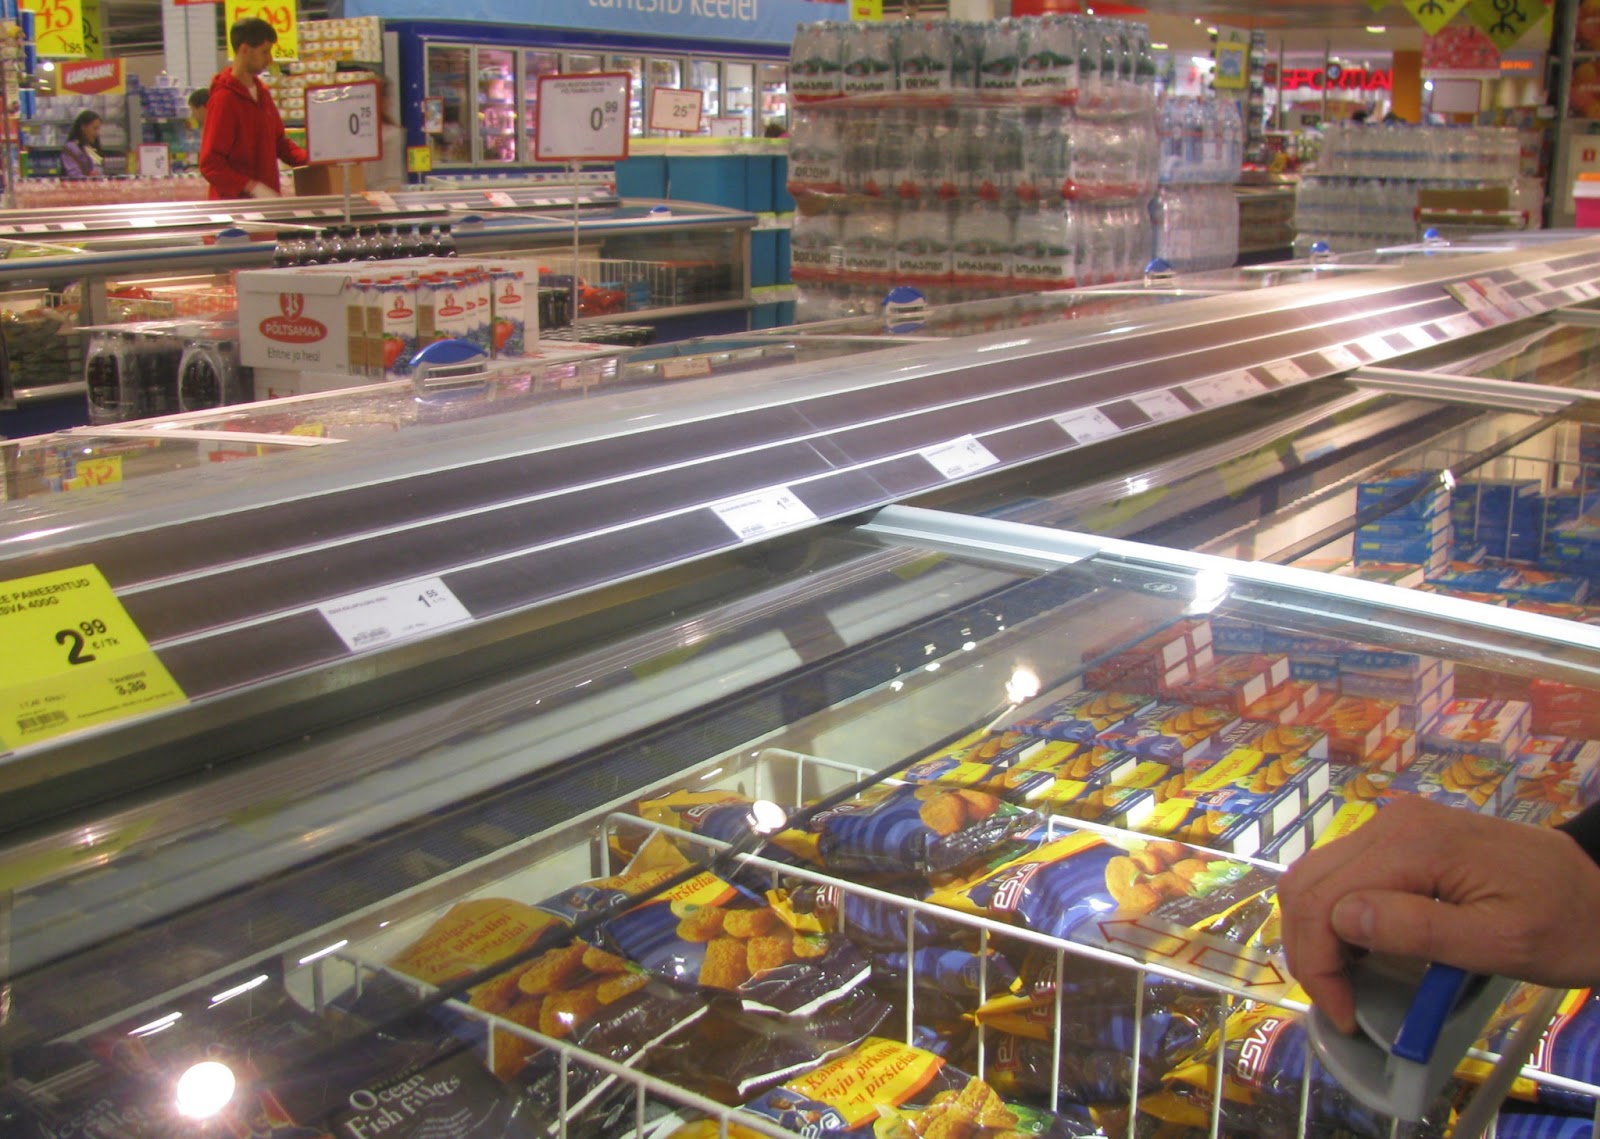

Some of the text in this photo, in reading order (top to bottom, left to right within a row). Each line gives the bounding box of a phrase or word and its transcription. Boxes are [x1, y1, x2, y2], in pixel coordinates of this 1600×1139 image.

[265, 321, 321, 337] PÕLTSAMAA
[12, 578, 90, 600] PANEERITUD
[55, 619, 107, 665] 2 99
[350, 1074, 425, 1110] Ocean
[345, 1107, 403, 1139] Fish
